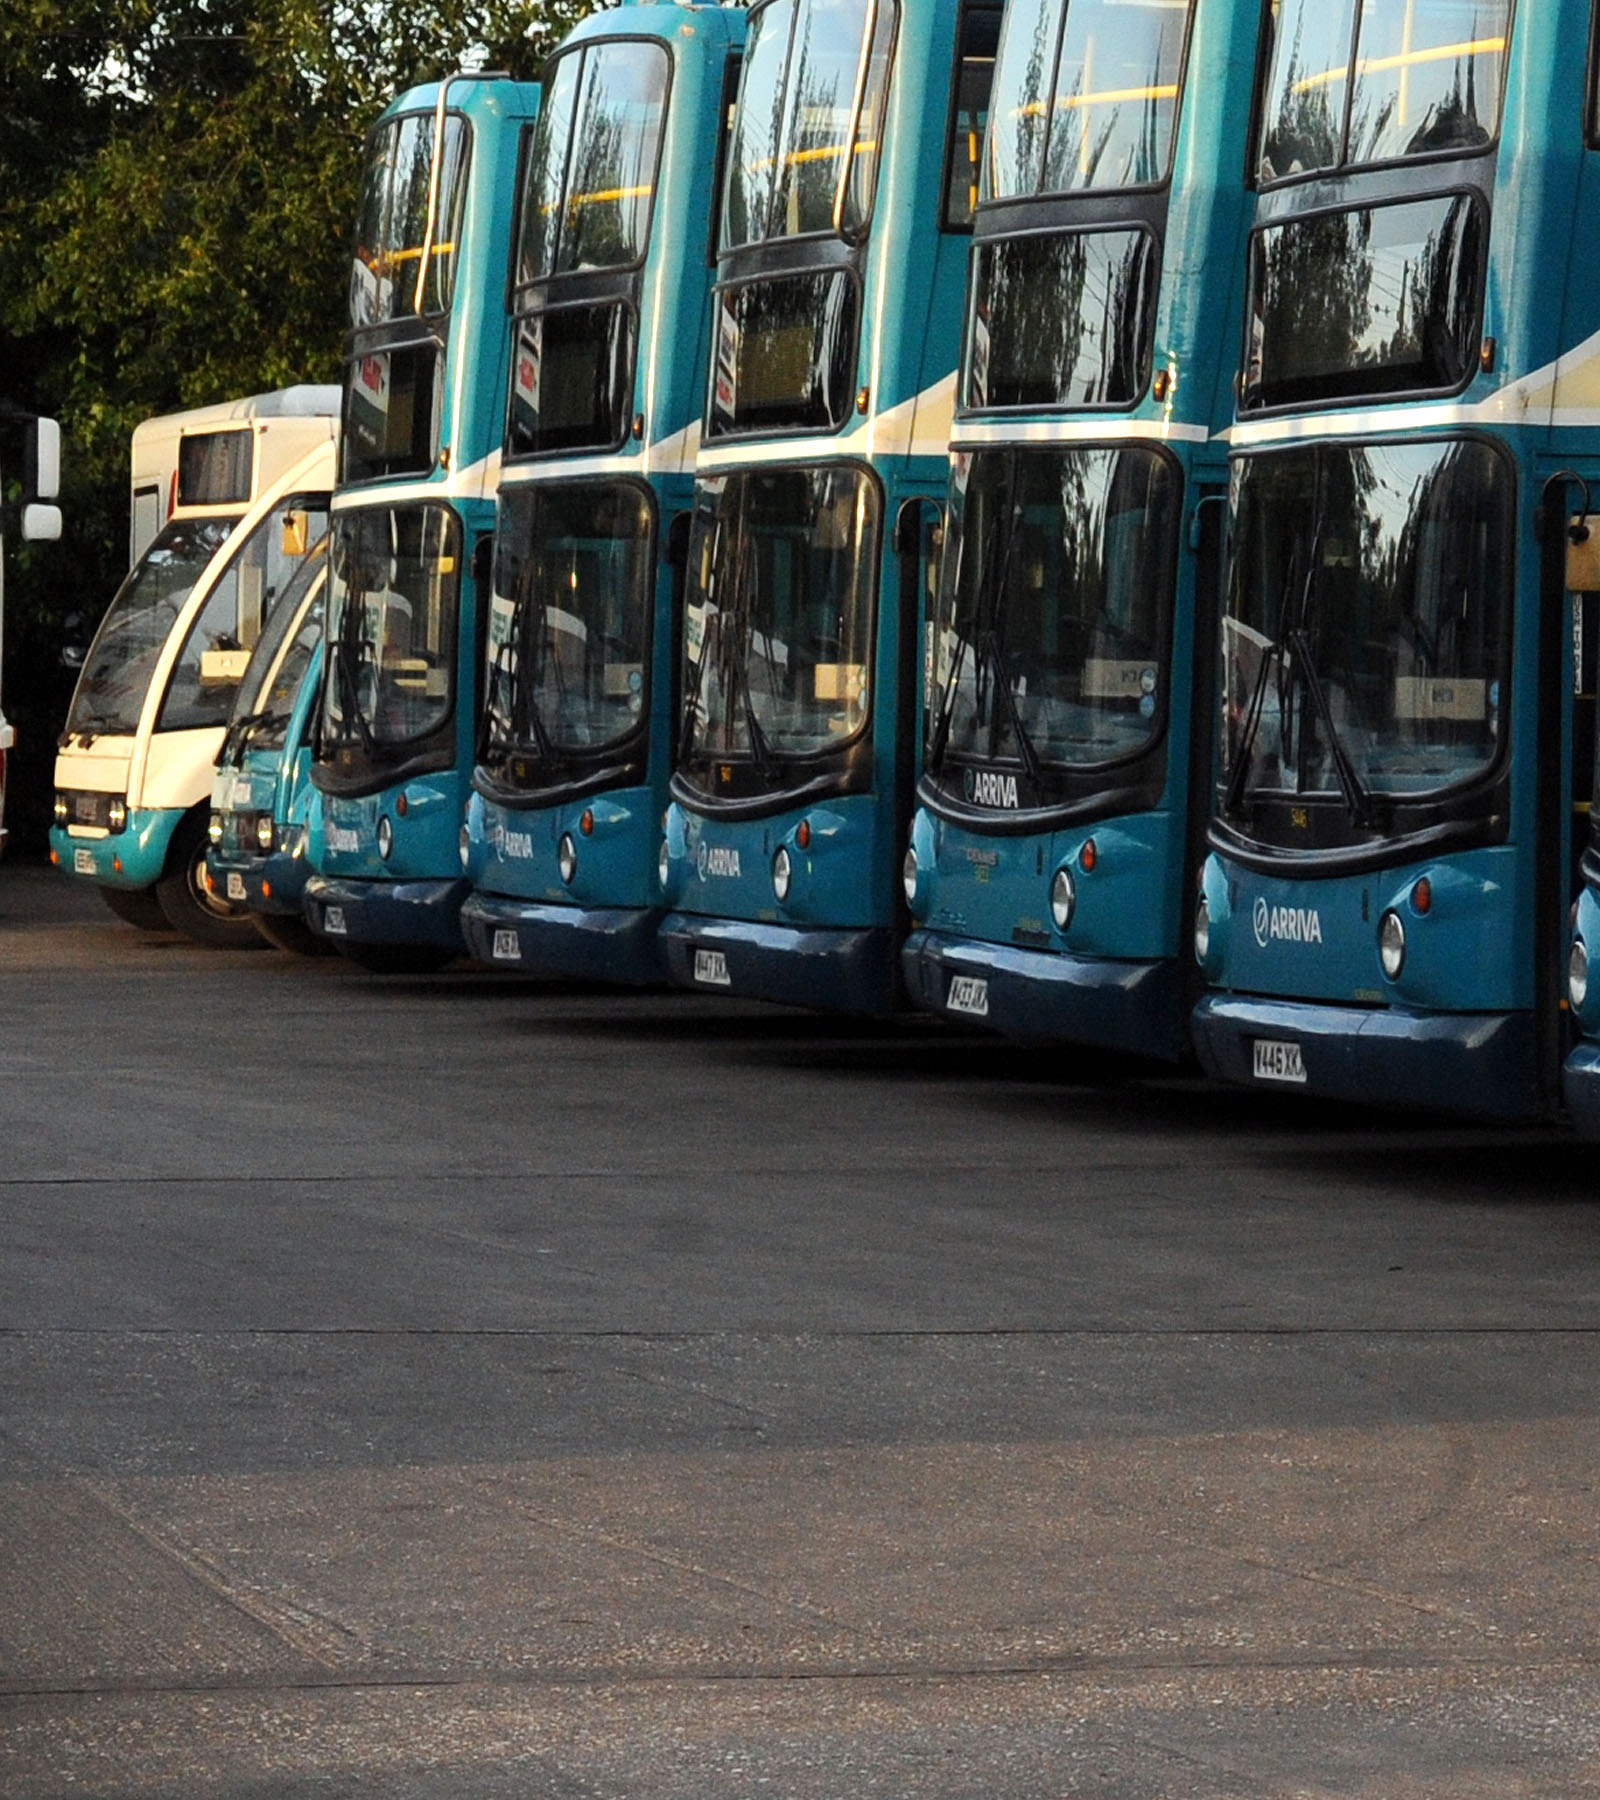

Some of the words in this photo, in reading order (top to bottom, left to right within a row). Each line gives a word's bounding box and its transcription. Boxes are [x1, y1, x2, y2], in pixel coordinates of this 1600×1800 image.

[974, 773, 1019, 809] ARRIVA
[707, 848, 742, 878] ARRIVA
[1270, 906, 1323, 944] ARRIVA
